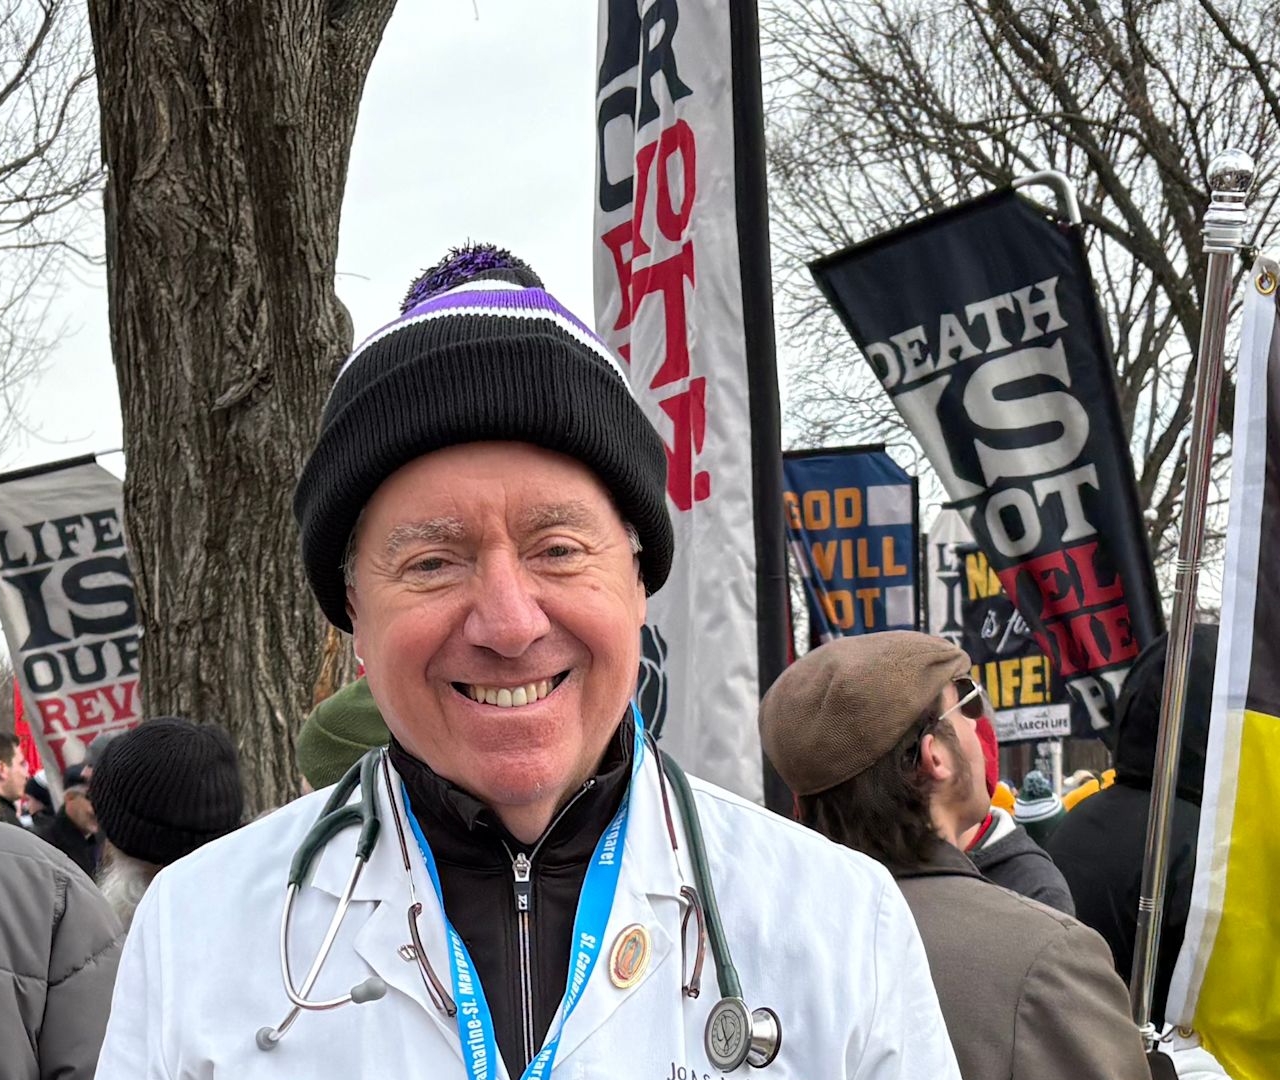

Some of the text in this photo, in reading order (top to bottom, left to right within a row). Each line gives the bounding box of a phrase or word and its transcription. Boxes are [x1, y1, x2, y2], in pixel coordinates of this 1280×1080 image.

[866, 276, 1068, 386] DEATH
[784, 487, 862, 531] GOD
[3, 555, 140, 652] IS
